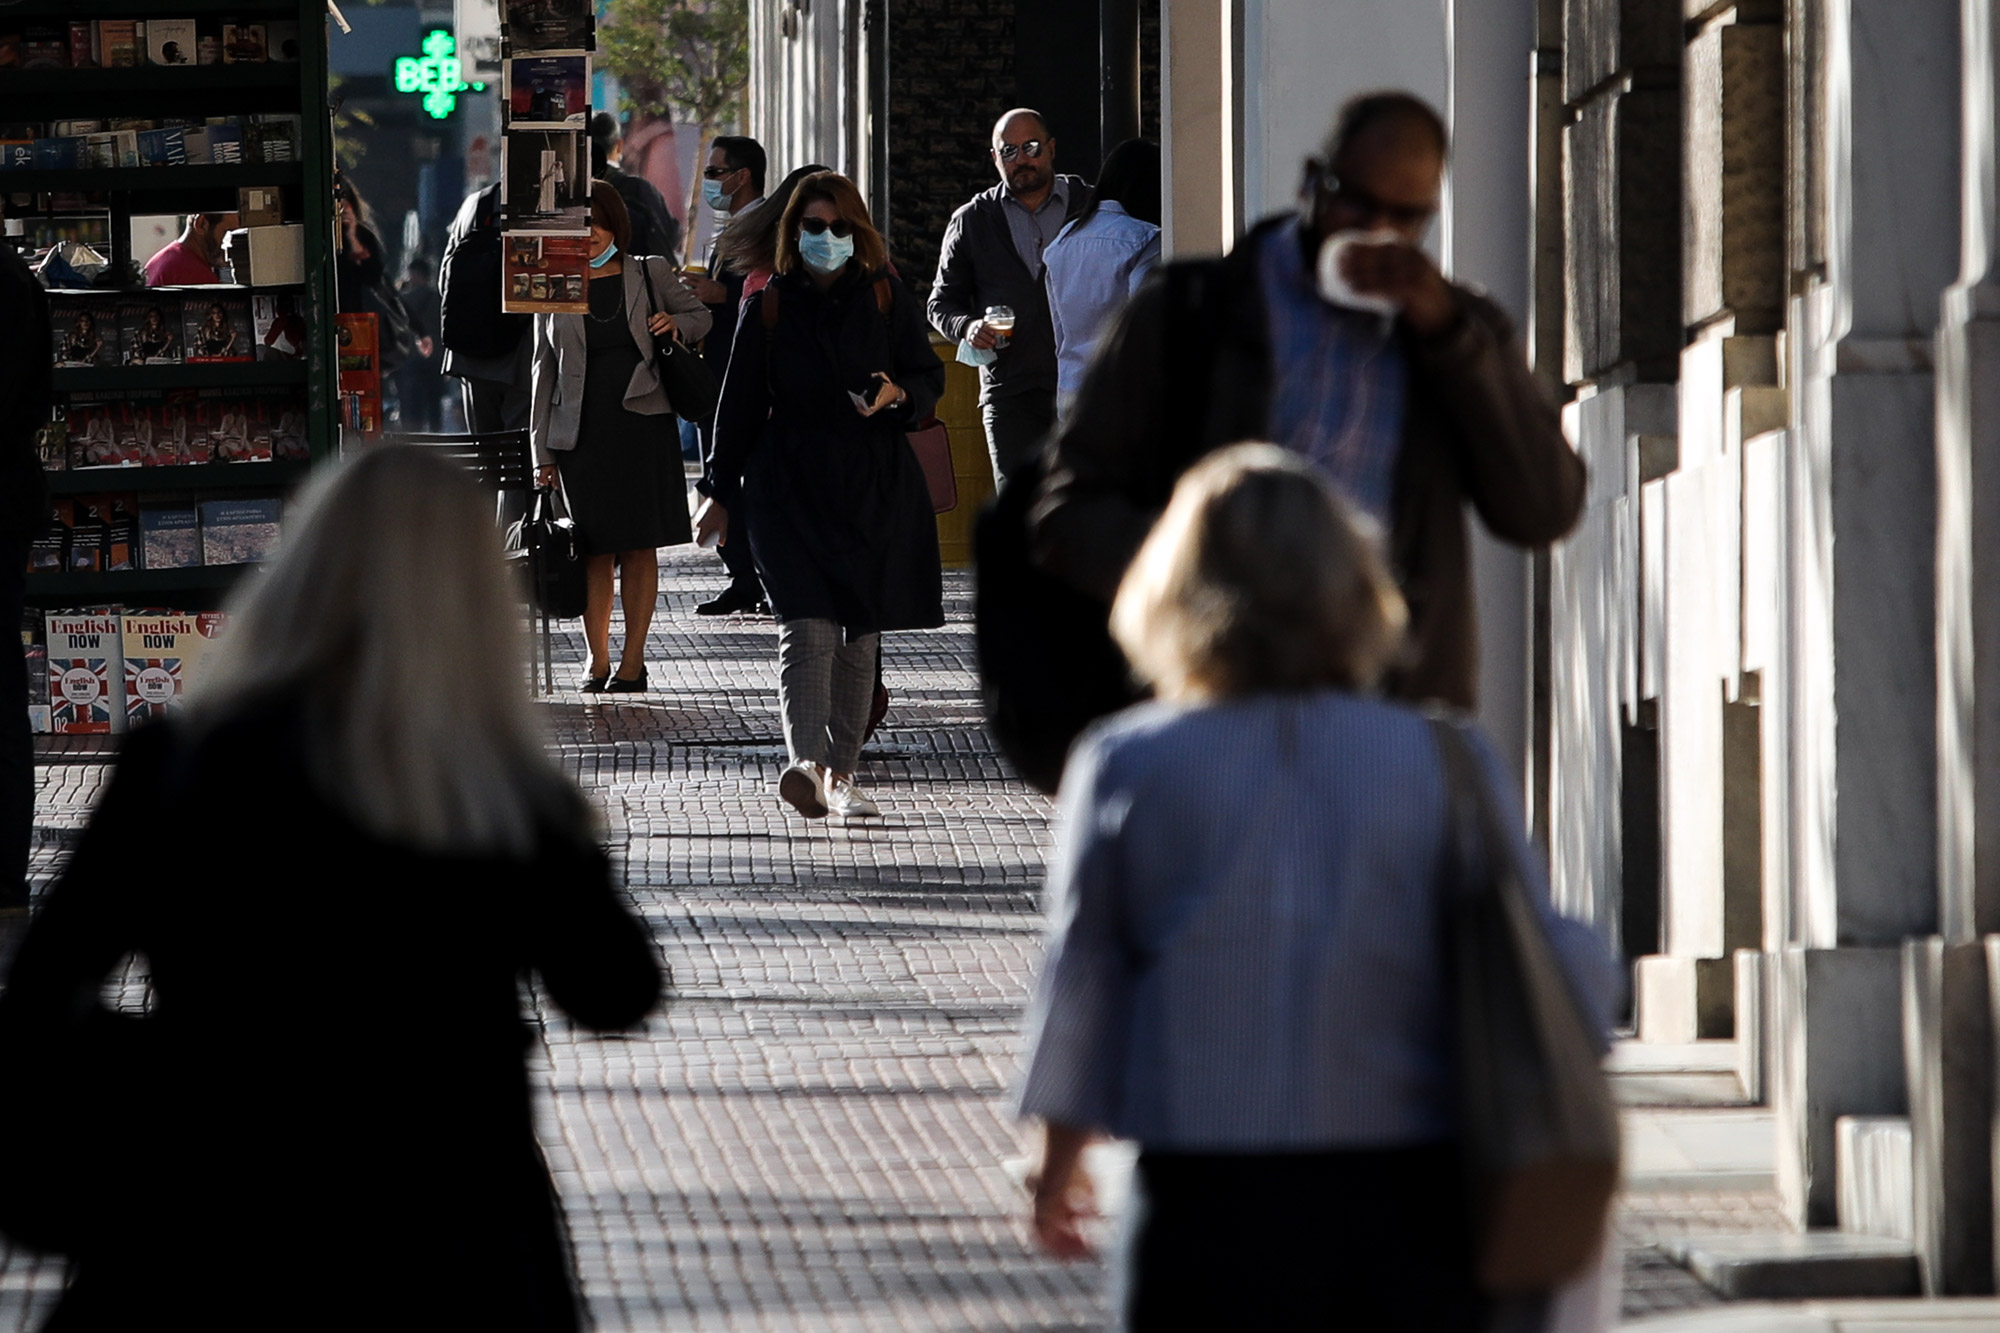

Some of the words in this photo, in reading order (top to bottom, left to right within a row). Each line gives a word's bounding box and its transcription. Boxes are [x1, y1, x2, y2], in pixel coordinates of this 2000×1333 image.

[51, 620, 117, 635] English
[126, 620, 192, 635] English
[68, 634, 100, 649] now
[143, 634, 175, 649] now
[54, 716, 69, 733] 02
